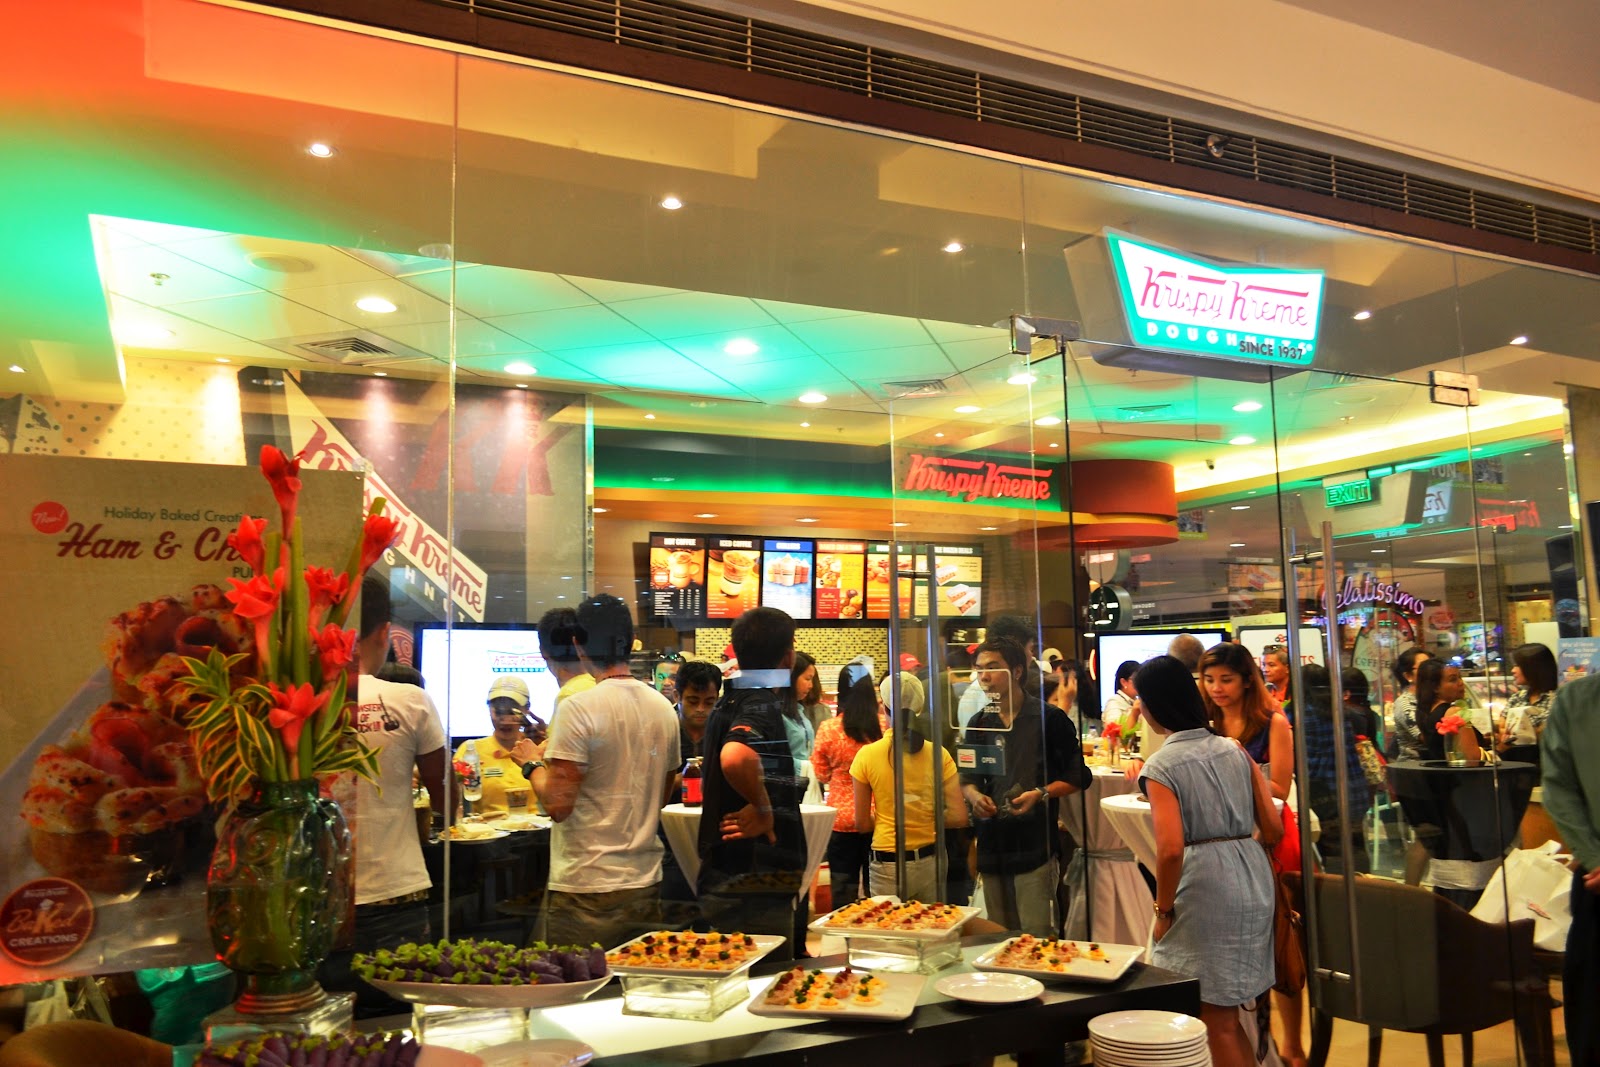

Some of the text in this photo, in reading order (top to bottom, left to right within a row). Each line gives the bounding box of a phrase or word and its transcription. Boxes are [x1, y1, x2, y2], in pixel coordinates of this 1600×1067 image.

[1140, 266, 1309, 327] Krispy Kreme
[1146, 321, 1307, 356] DOUGHNUTS
[1238, 340, 1304, 360] SINCE 1937
[904, 454, 1052, 502] Krispy Kreme
[1328, 485, 1369, 503] EXIT
[103, 506, 263, 523] Holiday Baked Creati
[56, 521, 142, 560] Ham
[154, 531, 182, 560] &
[9, 933, 79, 948] CREATIONS
